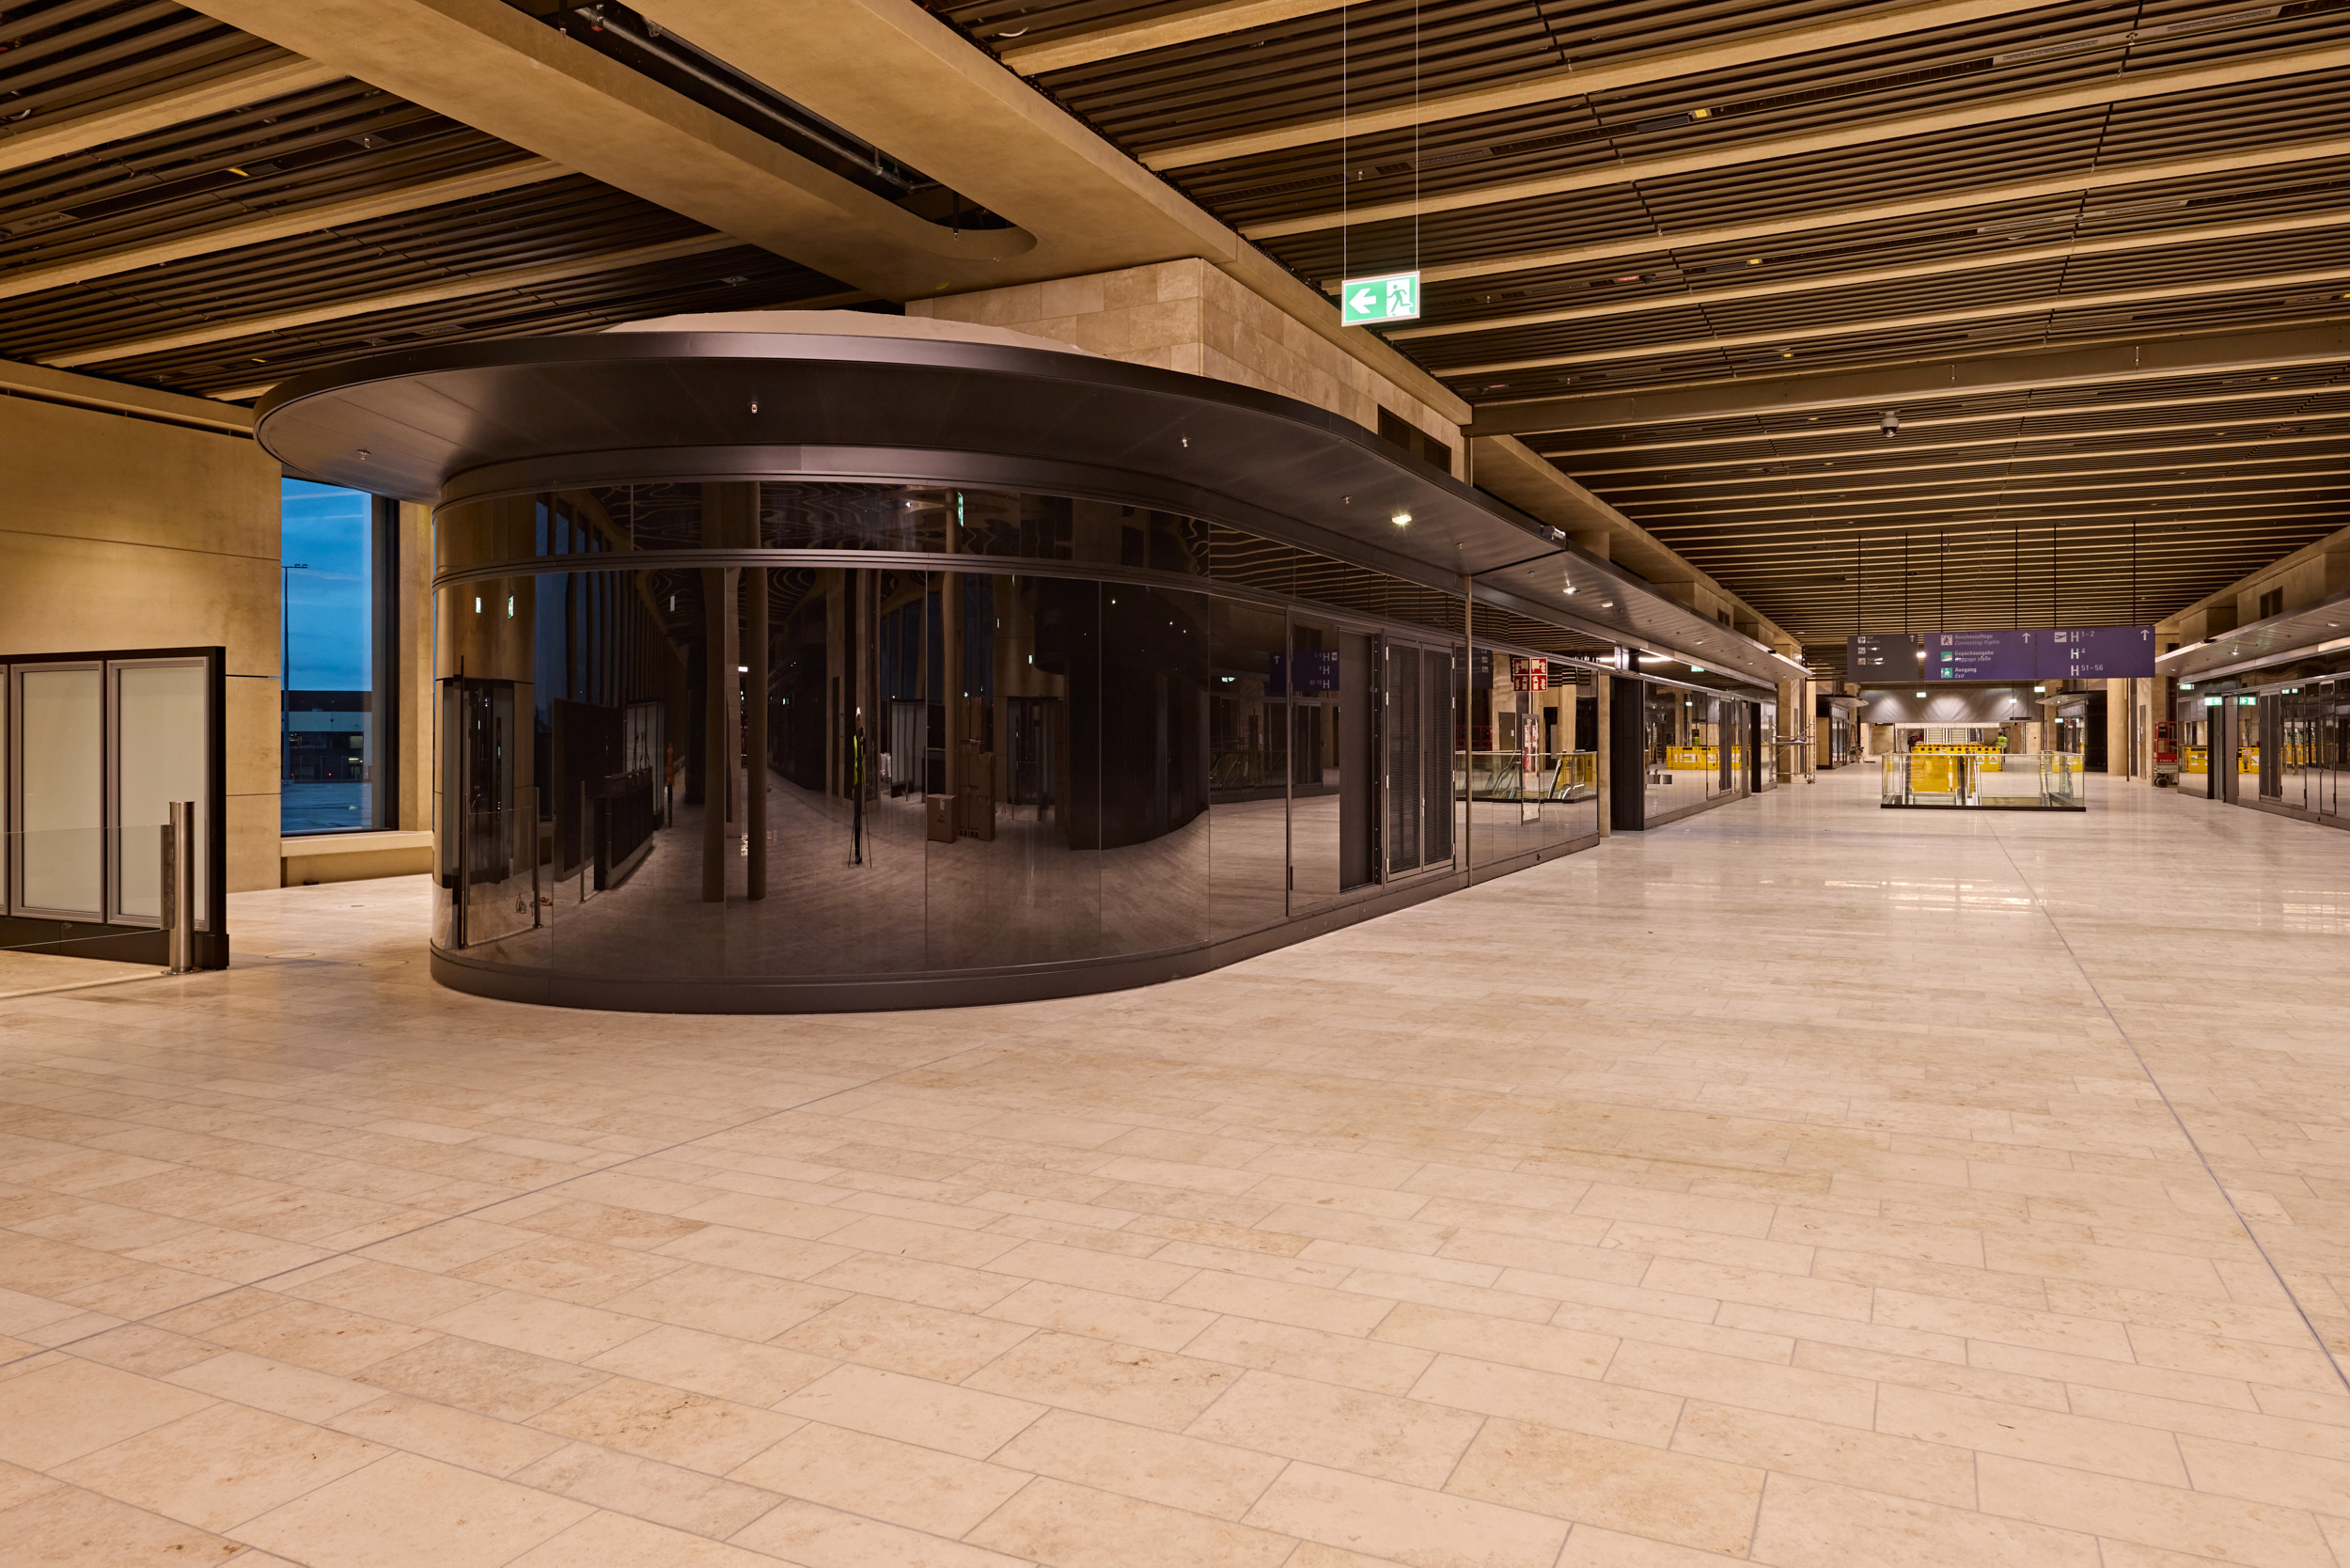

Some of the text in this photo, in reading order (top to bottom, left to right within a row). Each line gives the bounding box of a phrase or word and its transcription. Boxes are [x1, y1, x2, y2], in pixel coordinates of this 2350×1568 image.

[2071, 631, 2079, 642] H
[2071, 648, 2079, 660] H
[2071, 665, 2079, 676] H
